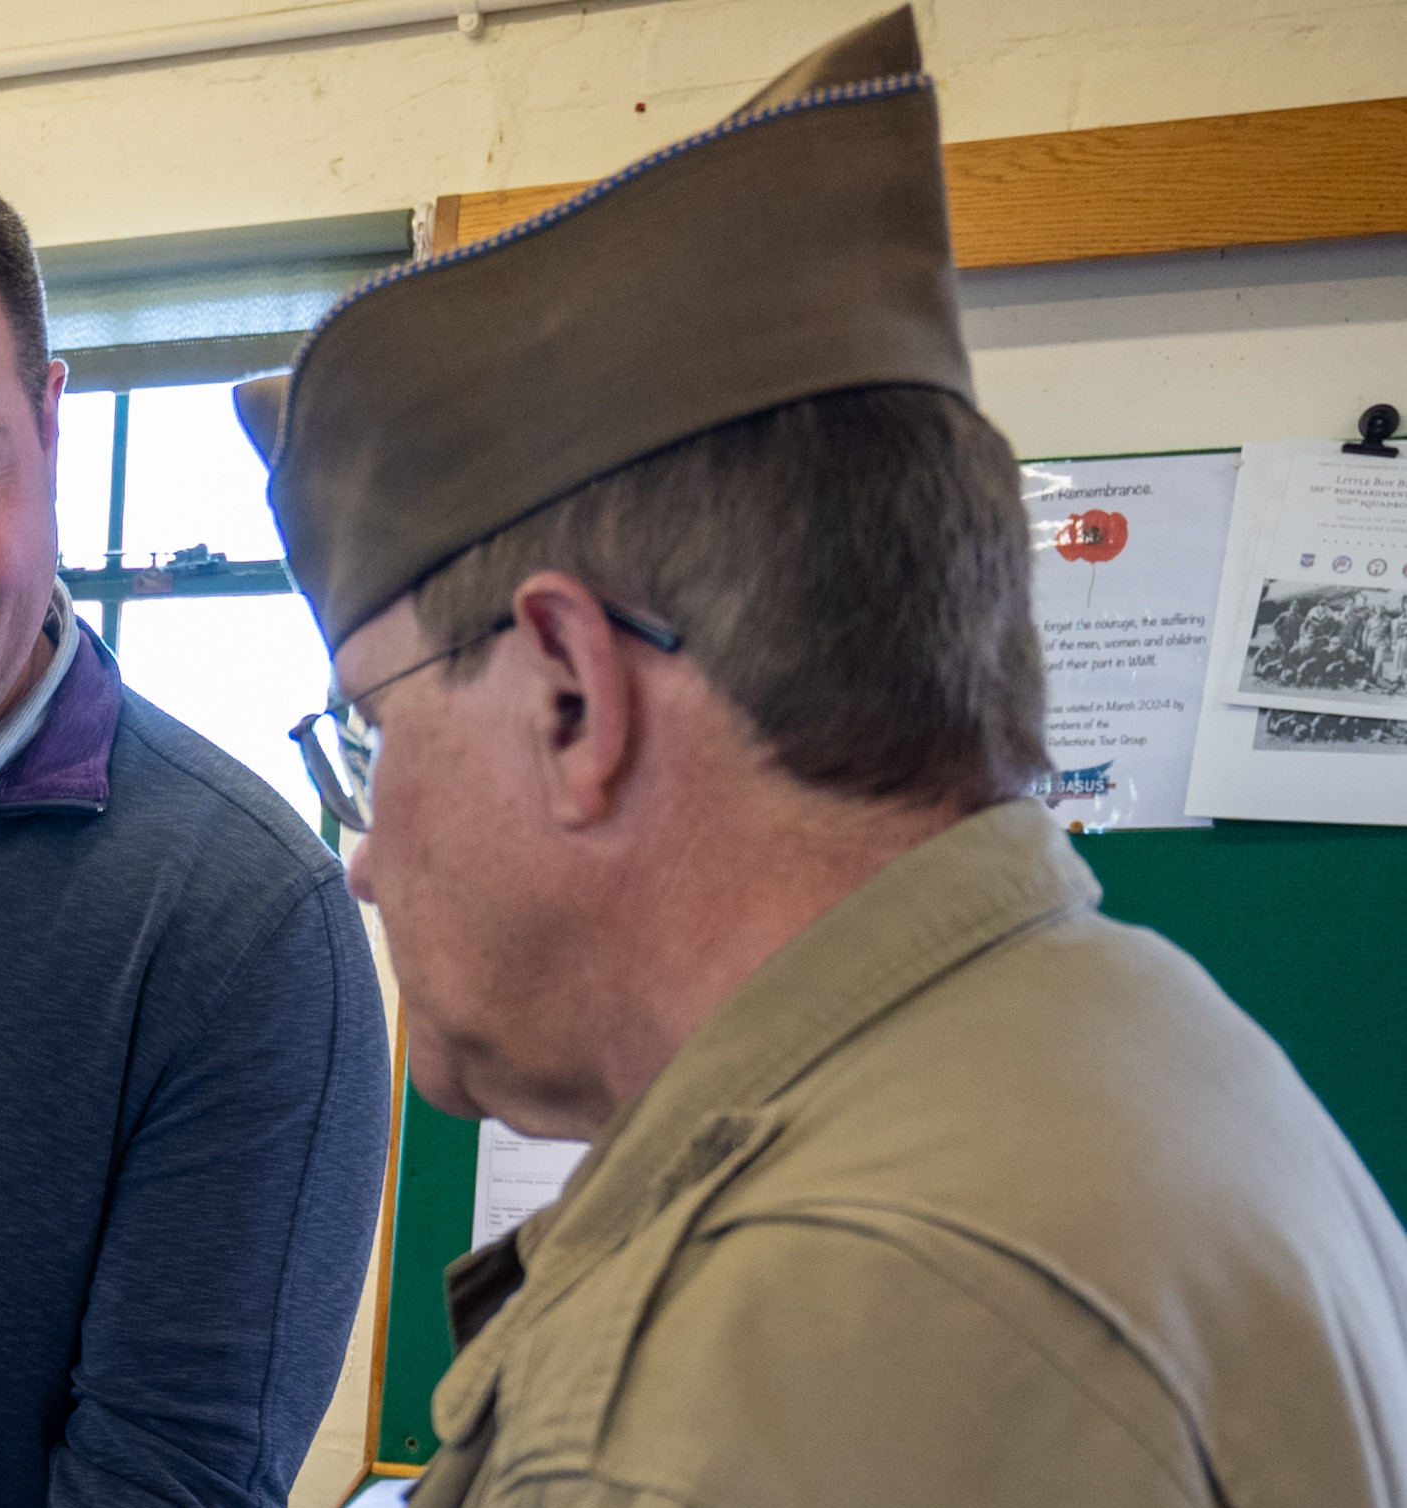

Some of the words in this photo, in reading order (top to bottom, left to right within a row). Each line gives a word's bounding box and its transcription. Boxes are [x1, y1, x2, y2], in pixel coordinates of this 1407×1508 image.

[1360, 499, 1407, 510] SQUADRO
[1043, 619, 1072, 634] forget
[1059, 637, 1074, 650] the
[1104, 638, 1141, 649] women
[1143, 634, 1164, 648] and
[1166, 632, 1207, 646] children
[1067, 655, 1089, 670] their
[1091, 658, 1113, 672] part
[1116, 655, 1125, 668] in
[1096, 701, 1104, 712] in
[1106, 700, 1135, 712] March
[1137, 699, 1171, 711] 2024
[1173, 699, 1185, 713] by
[1083, 717, 1095, 730] of
[1096, 719, 1109, 730] the
